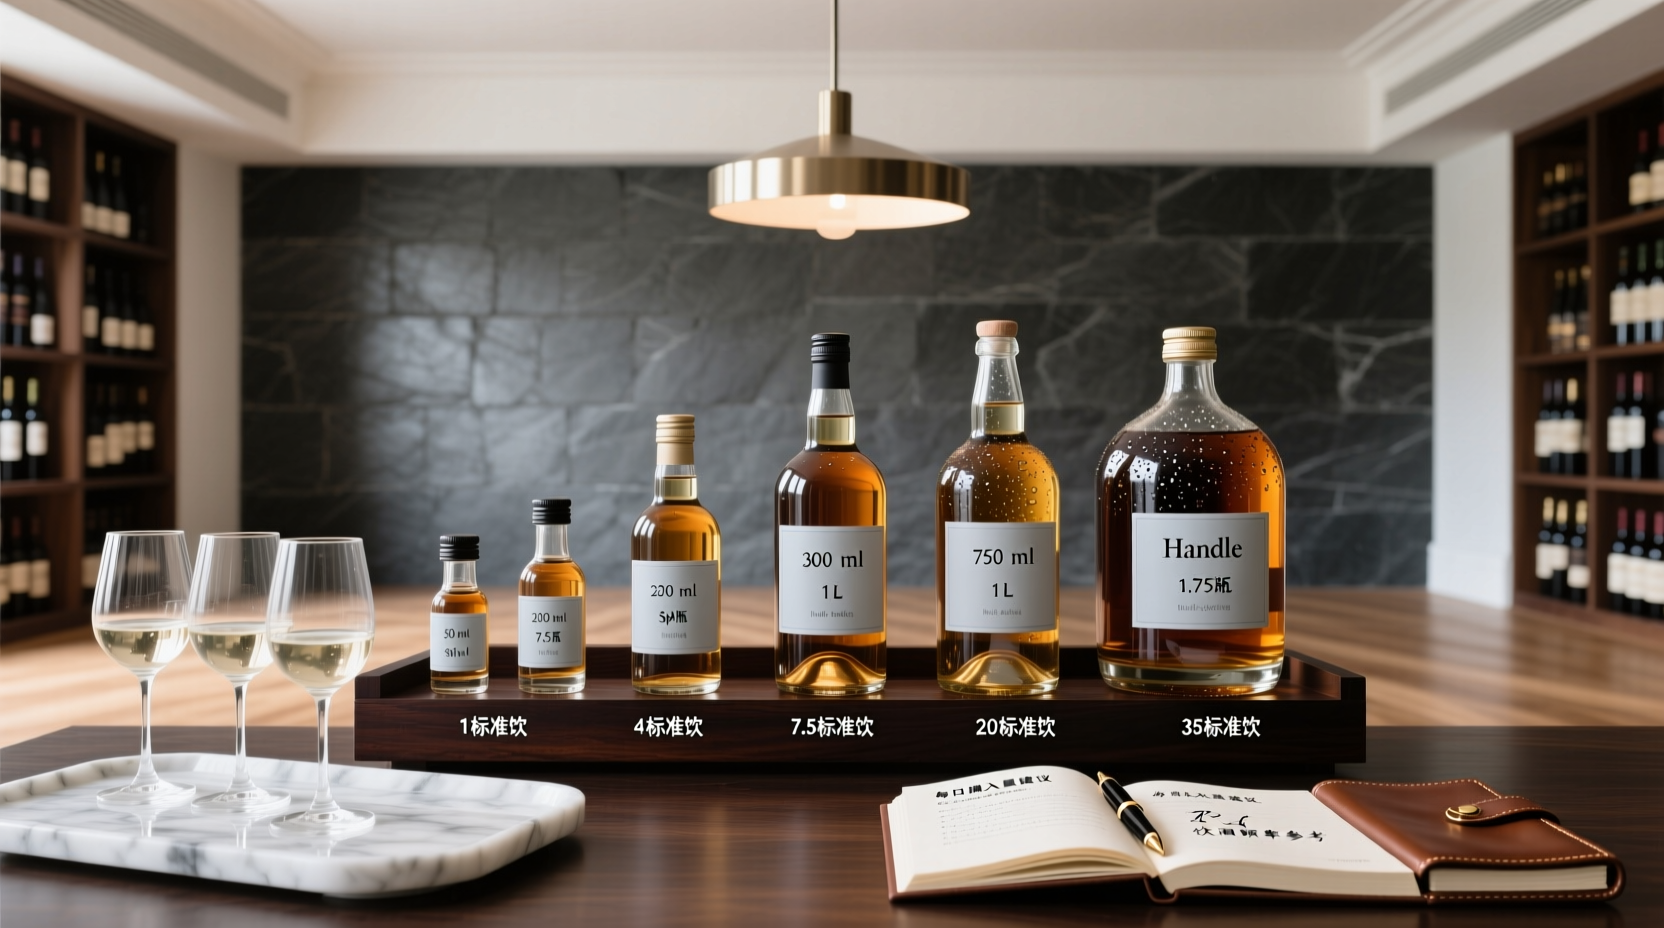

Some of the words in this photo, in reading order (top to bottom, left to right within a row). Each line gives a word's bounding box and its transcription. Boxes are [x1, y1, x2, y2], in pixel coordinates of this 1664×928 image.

[802, 551, 832, 568] 300
[841, 550, 864, 568] ml
[973, 548, 1003, 566] 750
[1012, 547, 1035, 565] ml
[1162, 537, 1243, 559] Handle
[679, 583, 697, 597] ml
[531, 612, 550, 623] 200
[443, 628, 455, 639] 50
[459, 715, 528, 737] 1标准饮
[633, 715, 704, 737] 4标准饮
[791, 716, 874, 738] 7.5标准饮
[975, 716, 1056, 738] 20标准饮
[1181, 716, 1261, 738] 35标准饮
